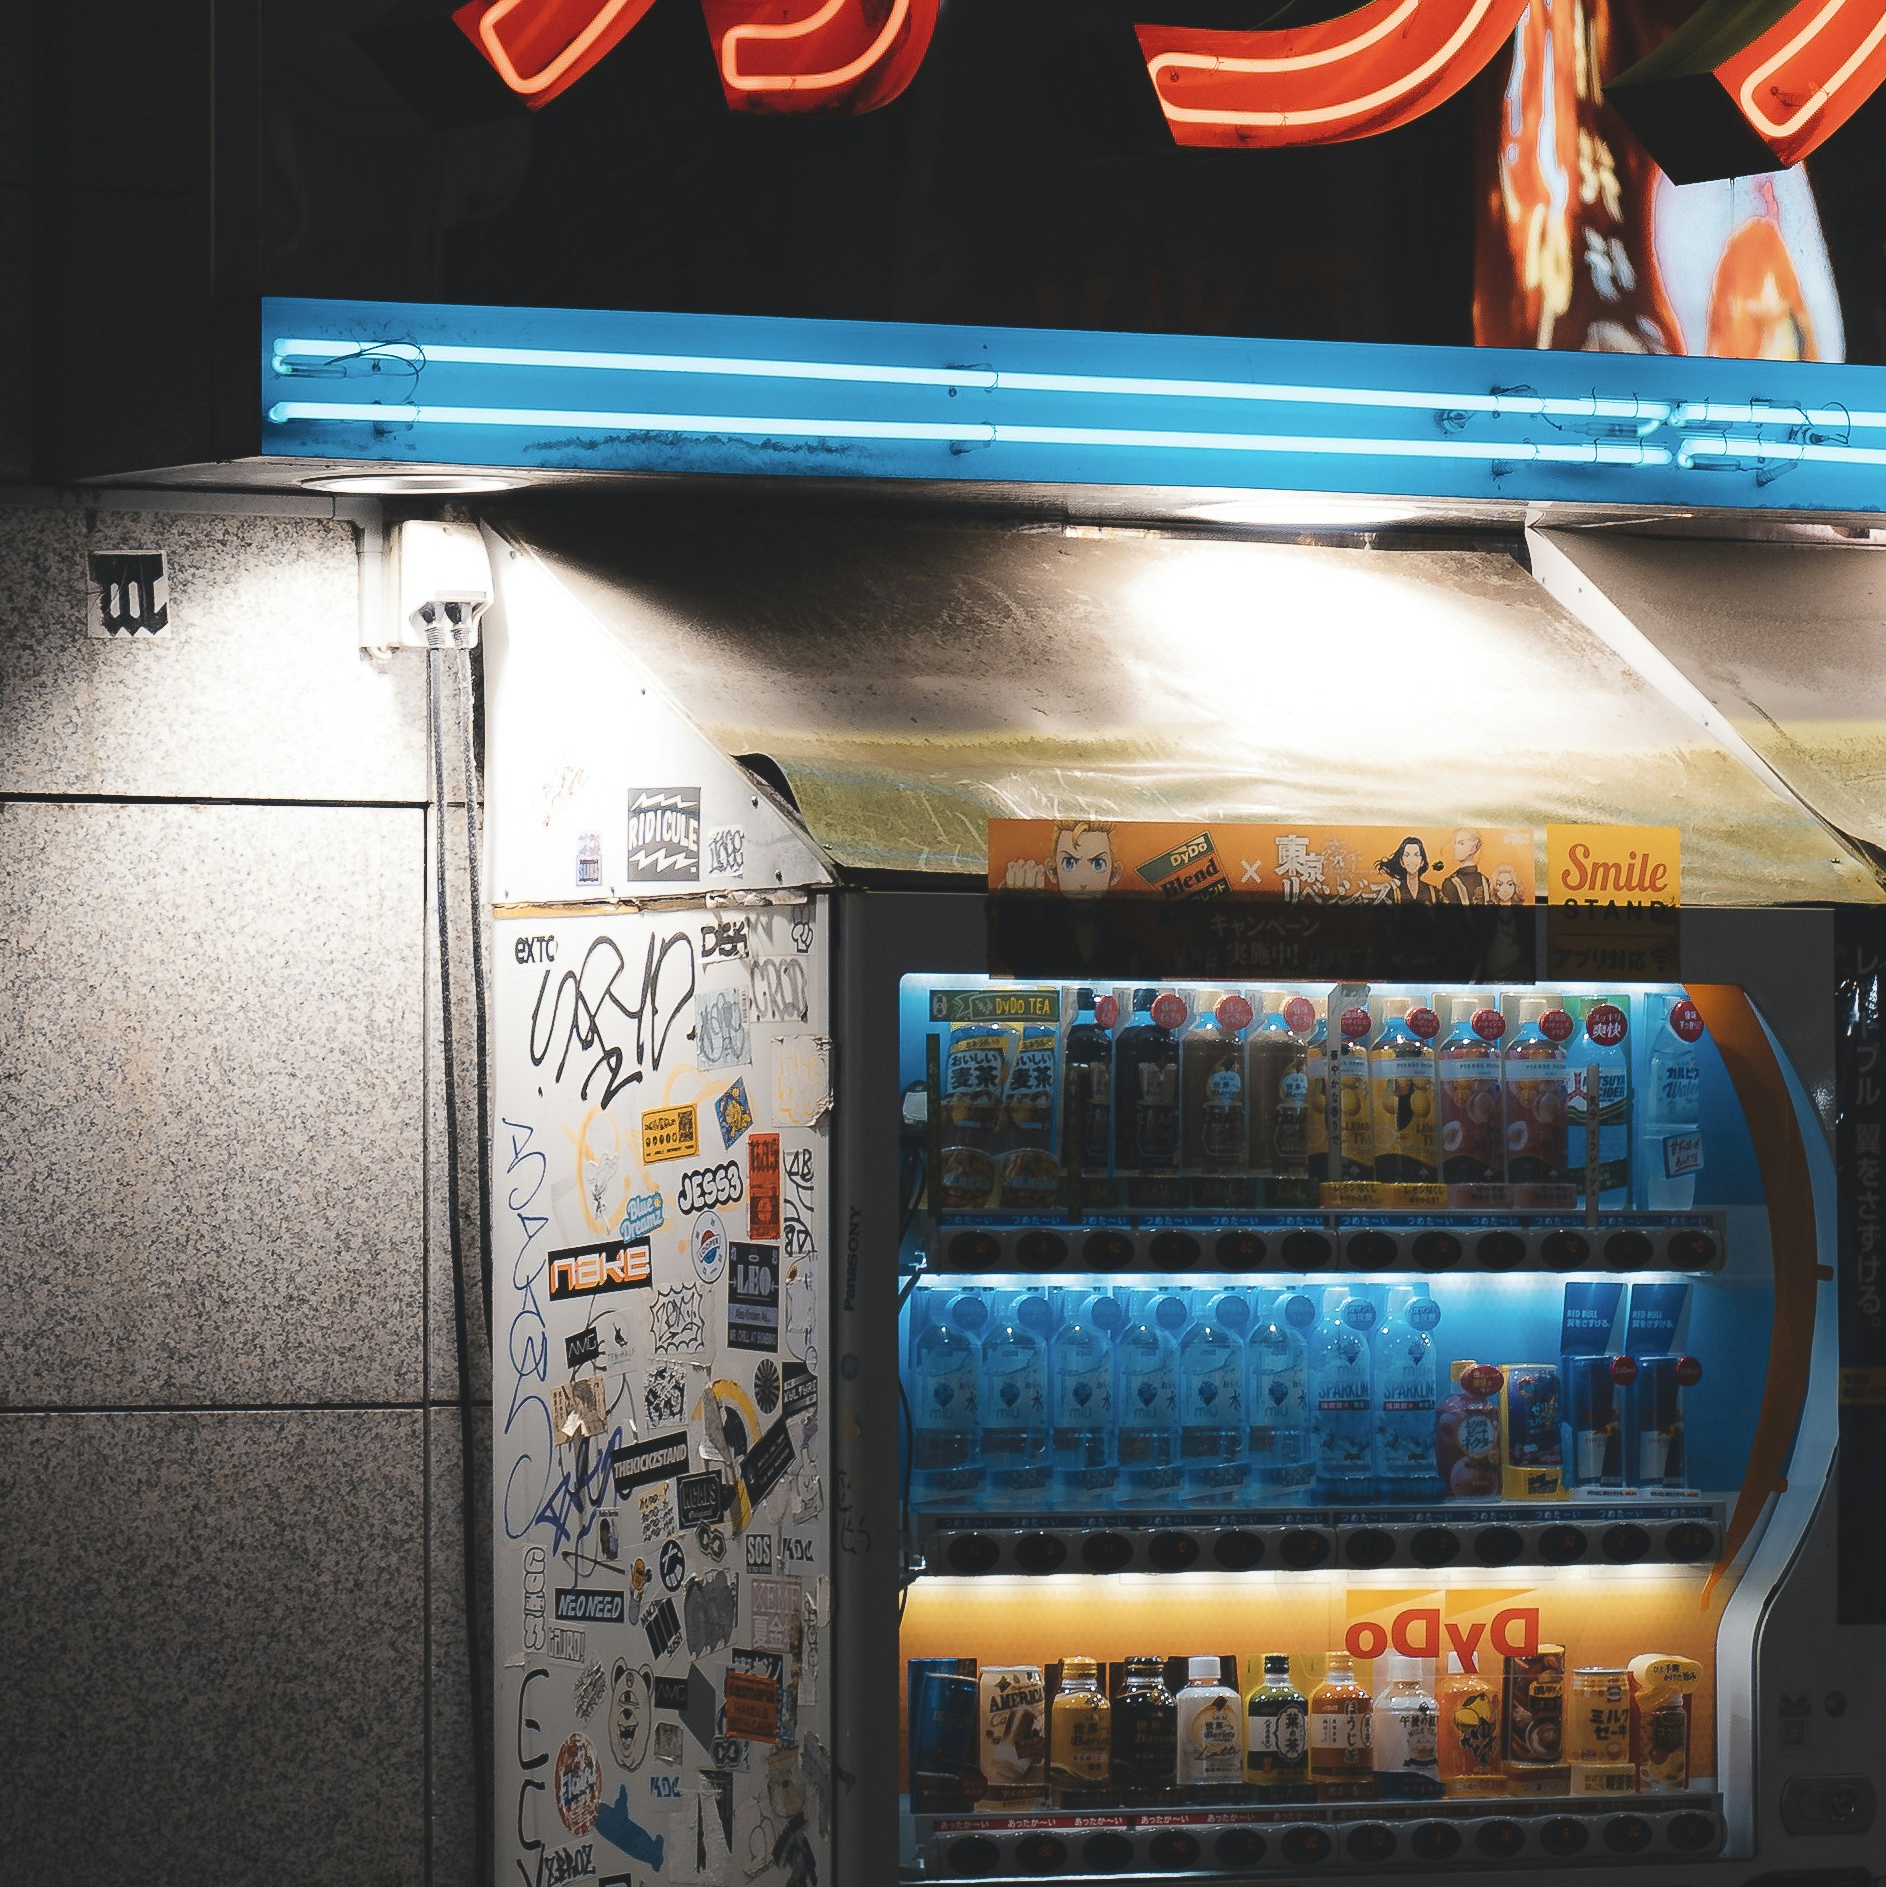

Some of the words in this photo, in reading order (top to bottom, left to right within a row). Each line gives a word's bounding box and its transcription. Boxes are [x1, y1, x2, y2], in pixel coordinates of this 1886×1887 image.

[629, 811, 698, 851] RIDICULE
[1169, 836, 1209, 867] DyDo
[1274, 834, 1324, 882] 東京
[1160, 861, 1220, 898] Blend
[1561, 843, 1667, 894] Smile
[1562, 898, 1666, 923] STAND
[995, 996, 1024, 1015] DyDo
[1028, 998, 1051, 1013] TEA
[1592, 1023, 1621, 1038] 爽快
[951, 1053, 999, 1065] おいしい
[950, 1066, 999, 1089] 麦茶
[627, 1195, 653, 1216] Blue
[737, 1264, 771, 1296] LEO
[748, 1537, 770, 1564] SOS
